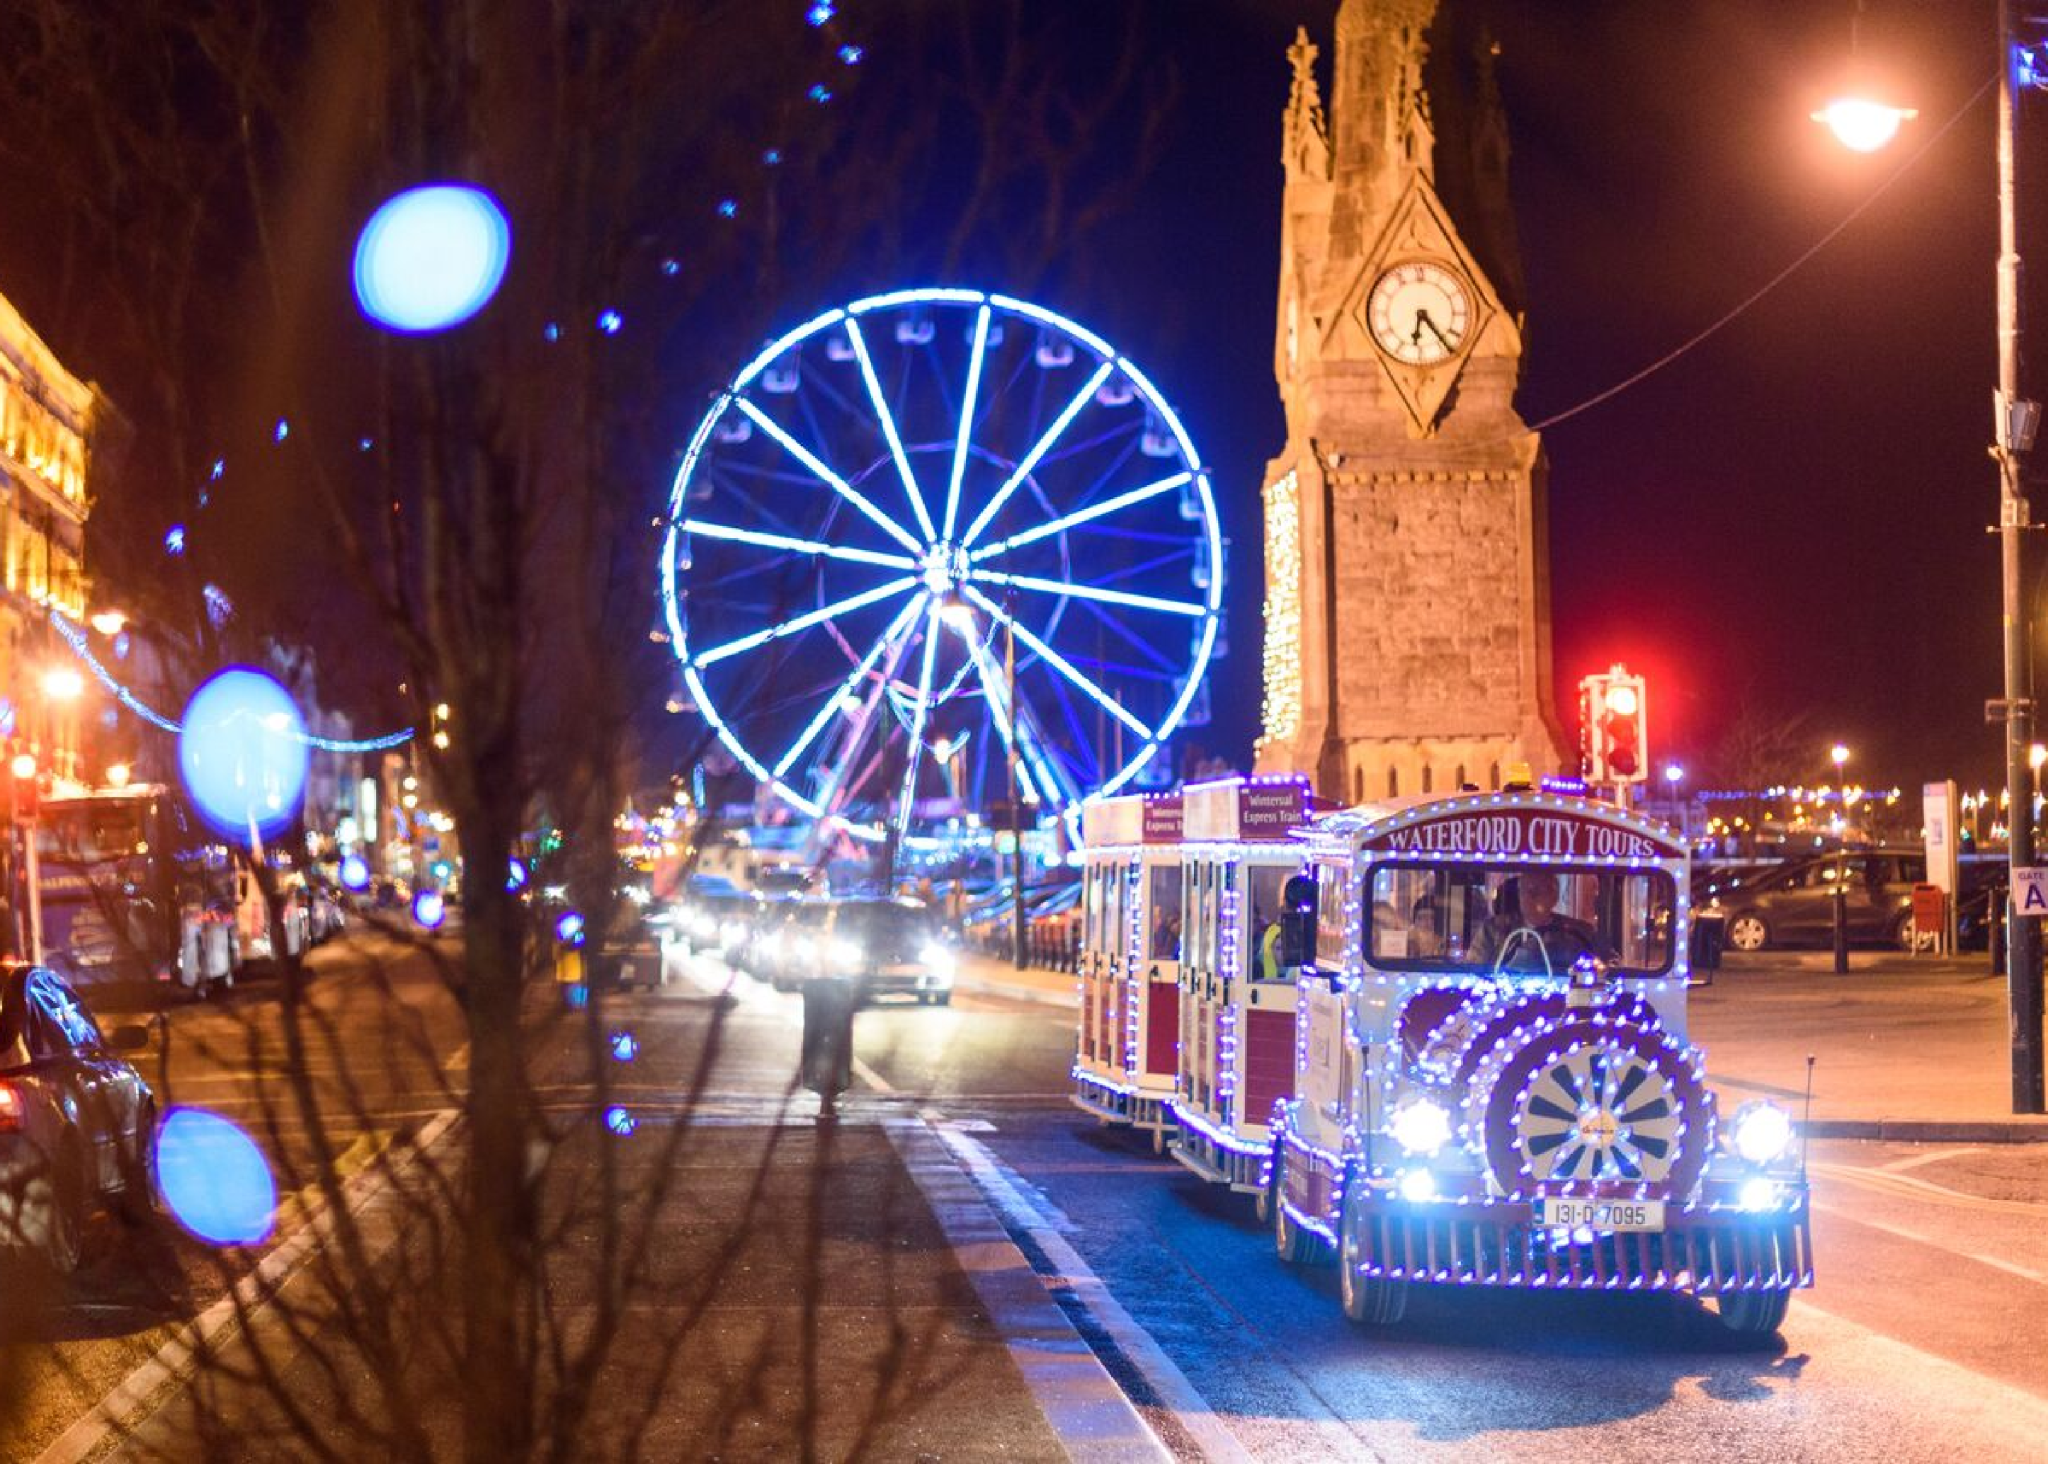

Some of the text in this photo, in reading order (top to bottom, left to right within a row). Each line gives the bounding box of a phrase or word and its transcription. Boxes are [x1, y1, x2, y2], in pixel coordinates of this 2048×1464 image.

[1243, 810, 1302, 826] Express Train
[1388, 816, 1655, 857] WATERFORD CITY TOURS
[2024, 884, 2047, 909] A
